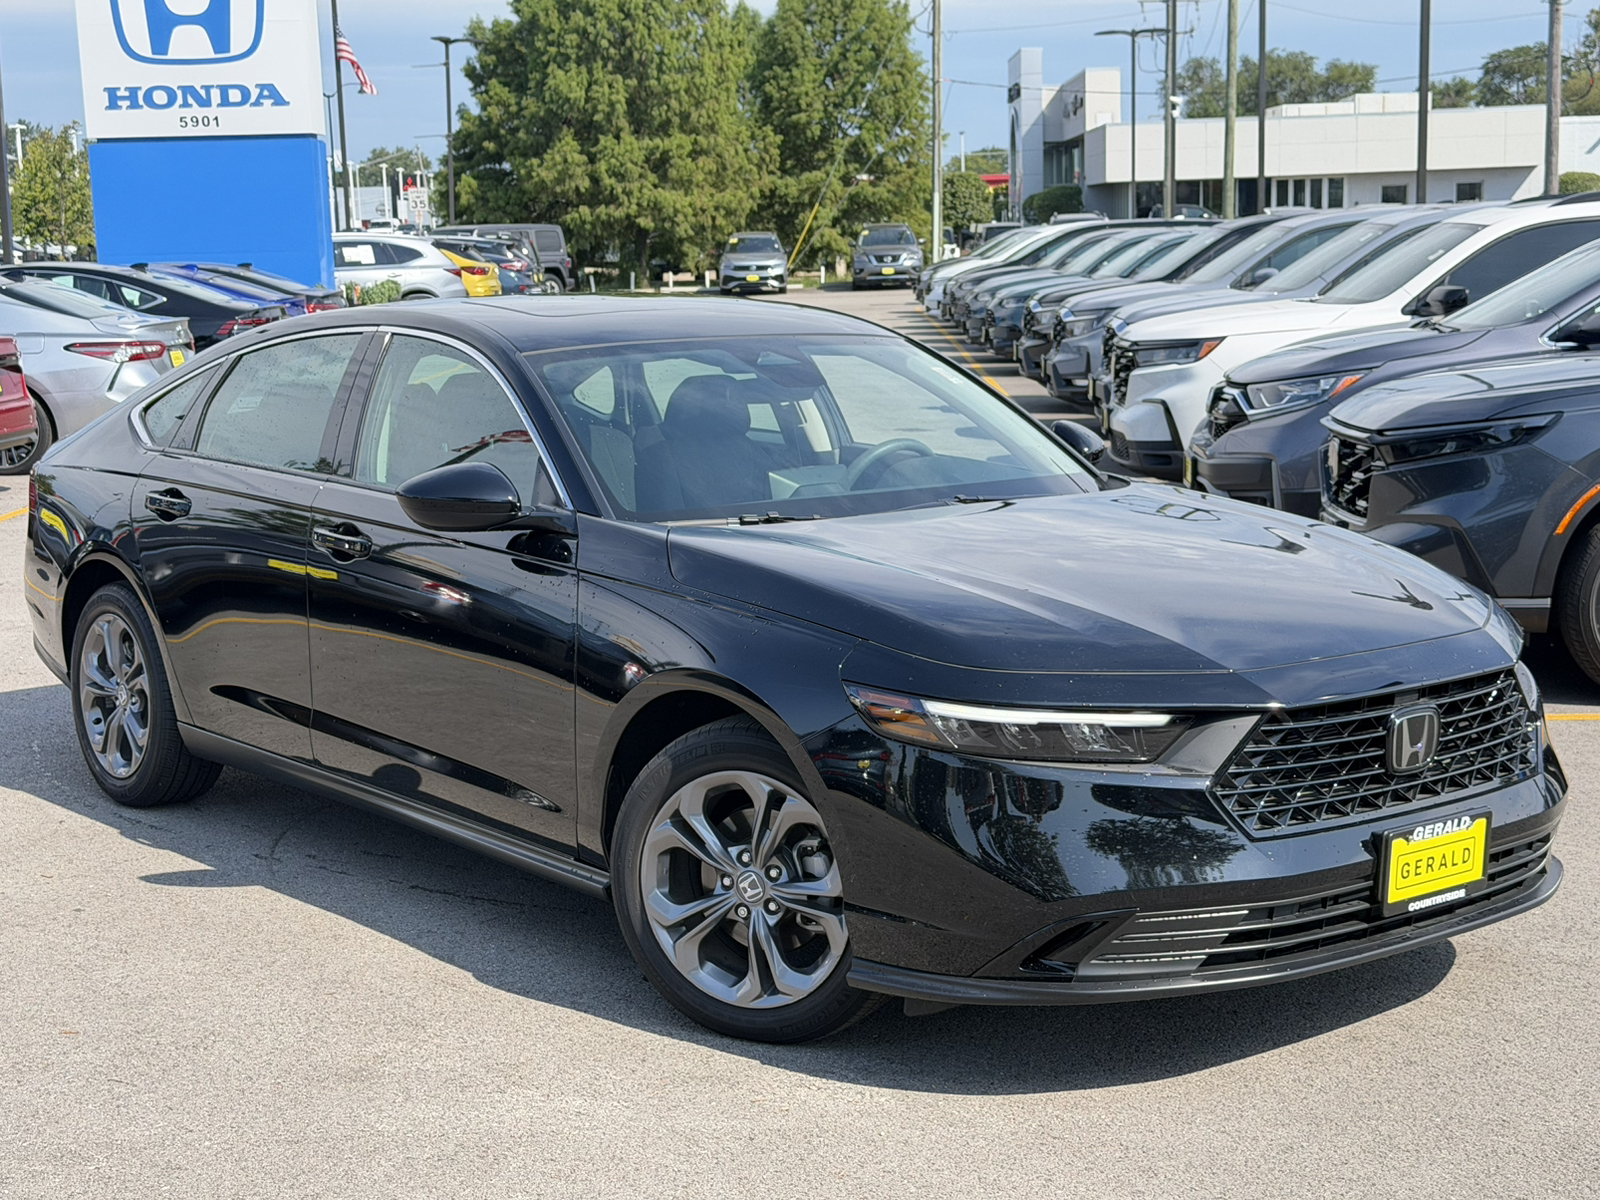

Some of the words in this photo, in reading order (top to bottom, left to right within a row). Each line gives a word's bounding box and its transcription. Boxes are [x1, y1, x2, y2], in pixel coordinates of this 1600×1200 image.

[103, 83, 291, 111] HONDA
[179, 115, 220, 128] 5901
[411, 200, 427, 209] 35
[1413, 816, 1471, 840] GERALD
[1401, 847, 1471, 880] GERALD
[1408, 889, 1466, 911] COUNTRYSIDE
